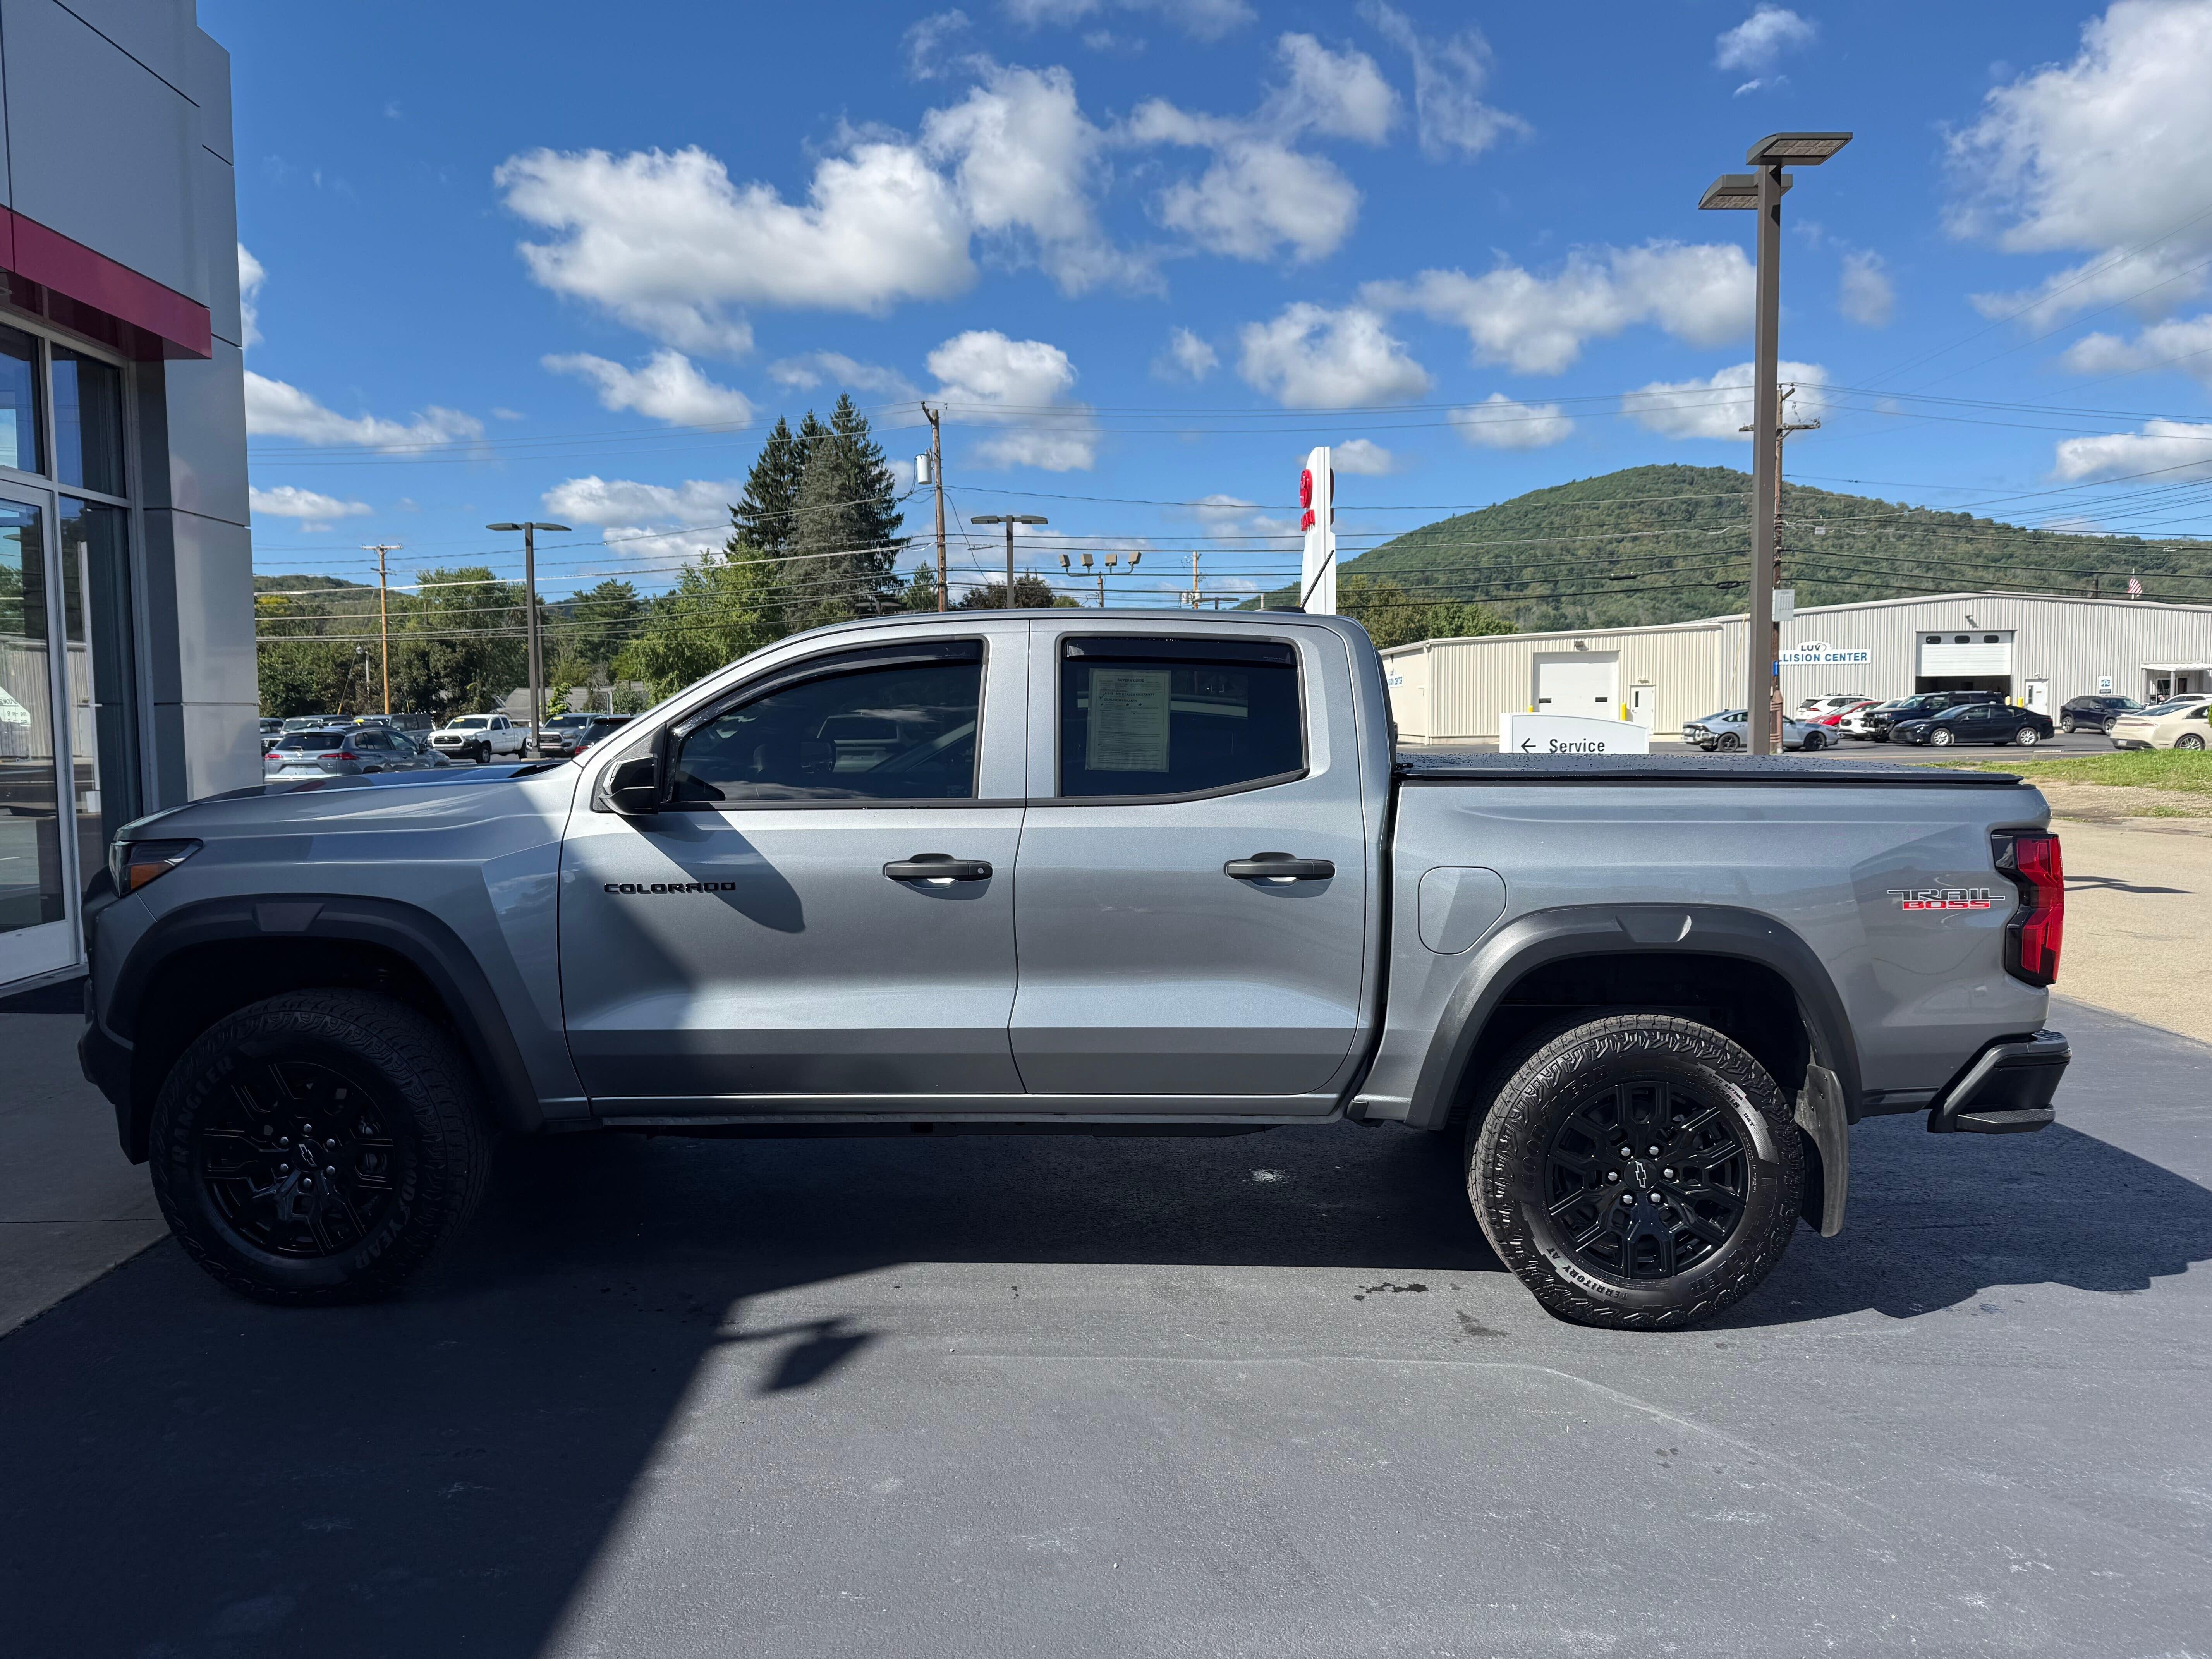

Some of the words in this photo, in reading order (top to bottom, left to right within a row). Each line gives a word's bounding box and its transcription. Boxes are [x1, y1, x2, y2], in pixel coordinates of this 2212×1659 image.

[1779, 653, 1820, 662] LISION
[1825, 652, 1867, 661] CENTER
[1549, 738, 1605, 753] Service
[604, 882, 736, 893] COLORADO
[1887, 888, 2006, 900] TRAIL
[1903, 899, 1991, 910] BOSS
[1546, 1247, 1561, 1259] AT
[1561, 1264, 1628, 1300] TERRITORY
